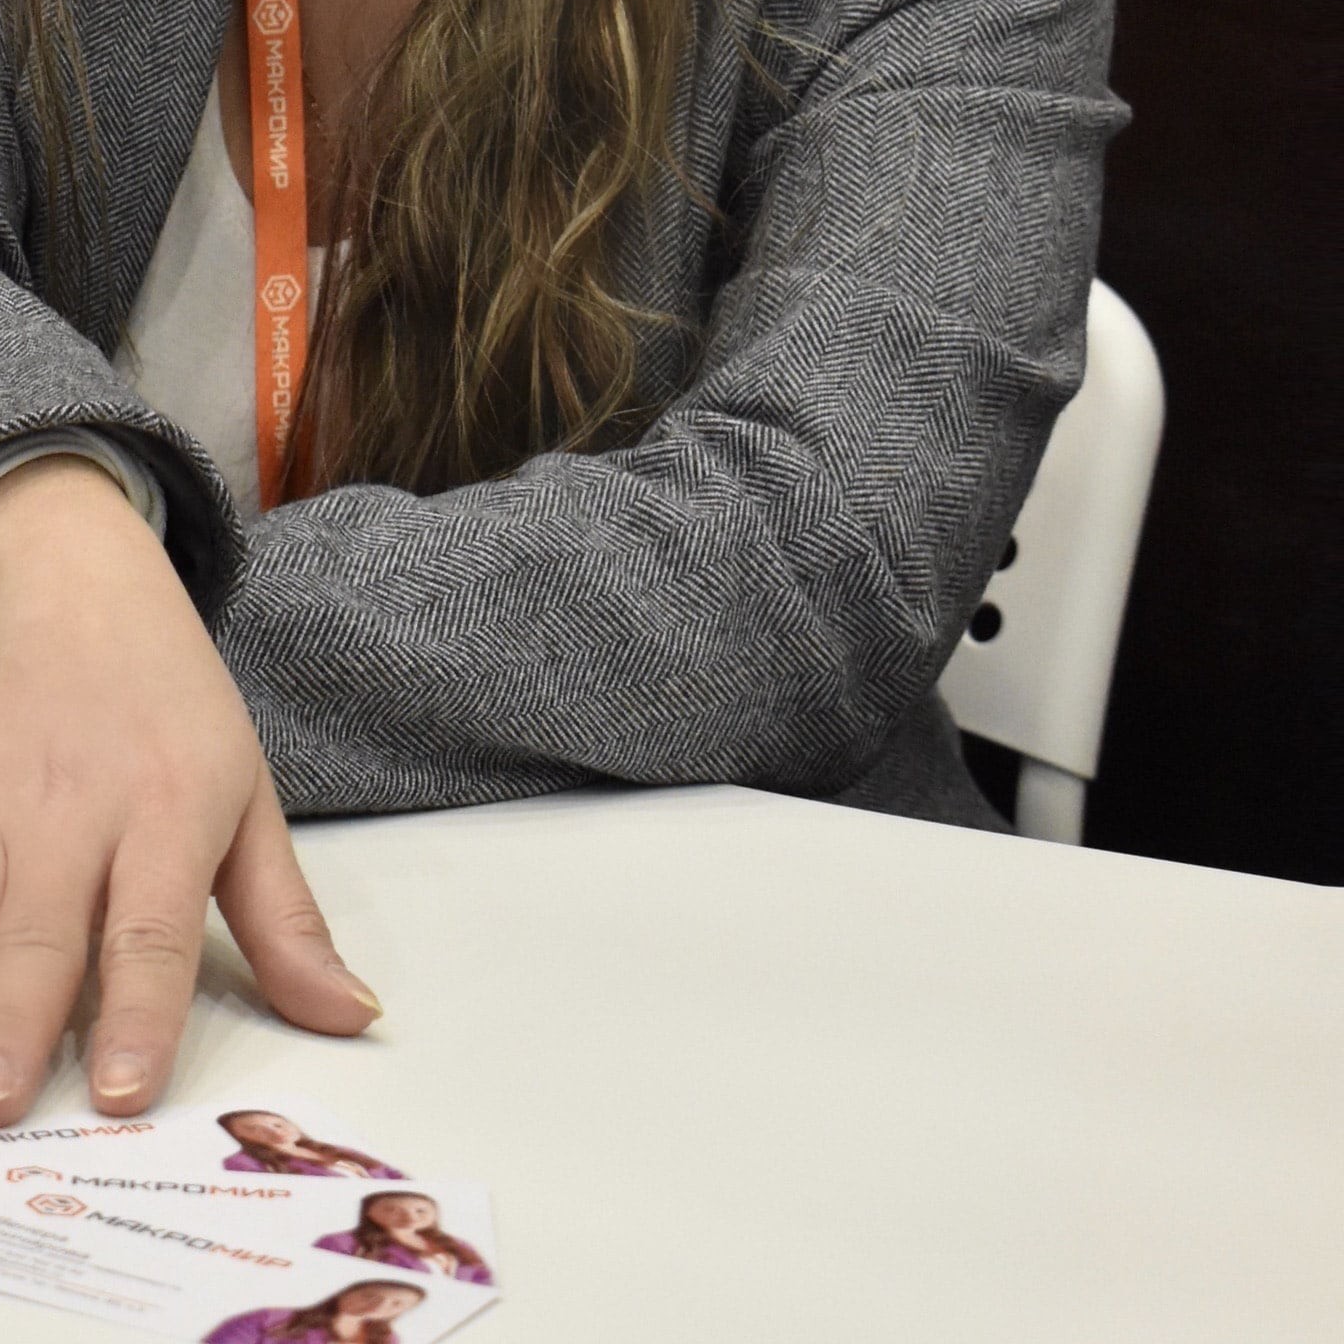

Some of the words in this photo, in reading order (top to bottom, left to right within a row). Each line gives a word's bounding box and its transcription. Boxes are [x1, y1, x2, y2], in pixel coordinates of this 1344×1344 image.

[266, 39, 289, 189] МАКРОМИР
[71, 1175, 293, 1199] МАКРОМИР
[85, 1211, 293, 1268] МАКРОМИР
